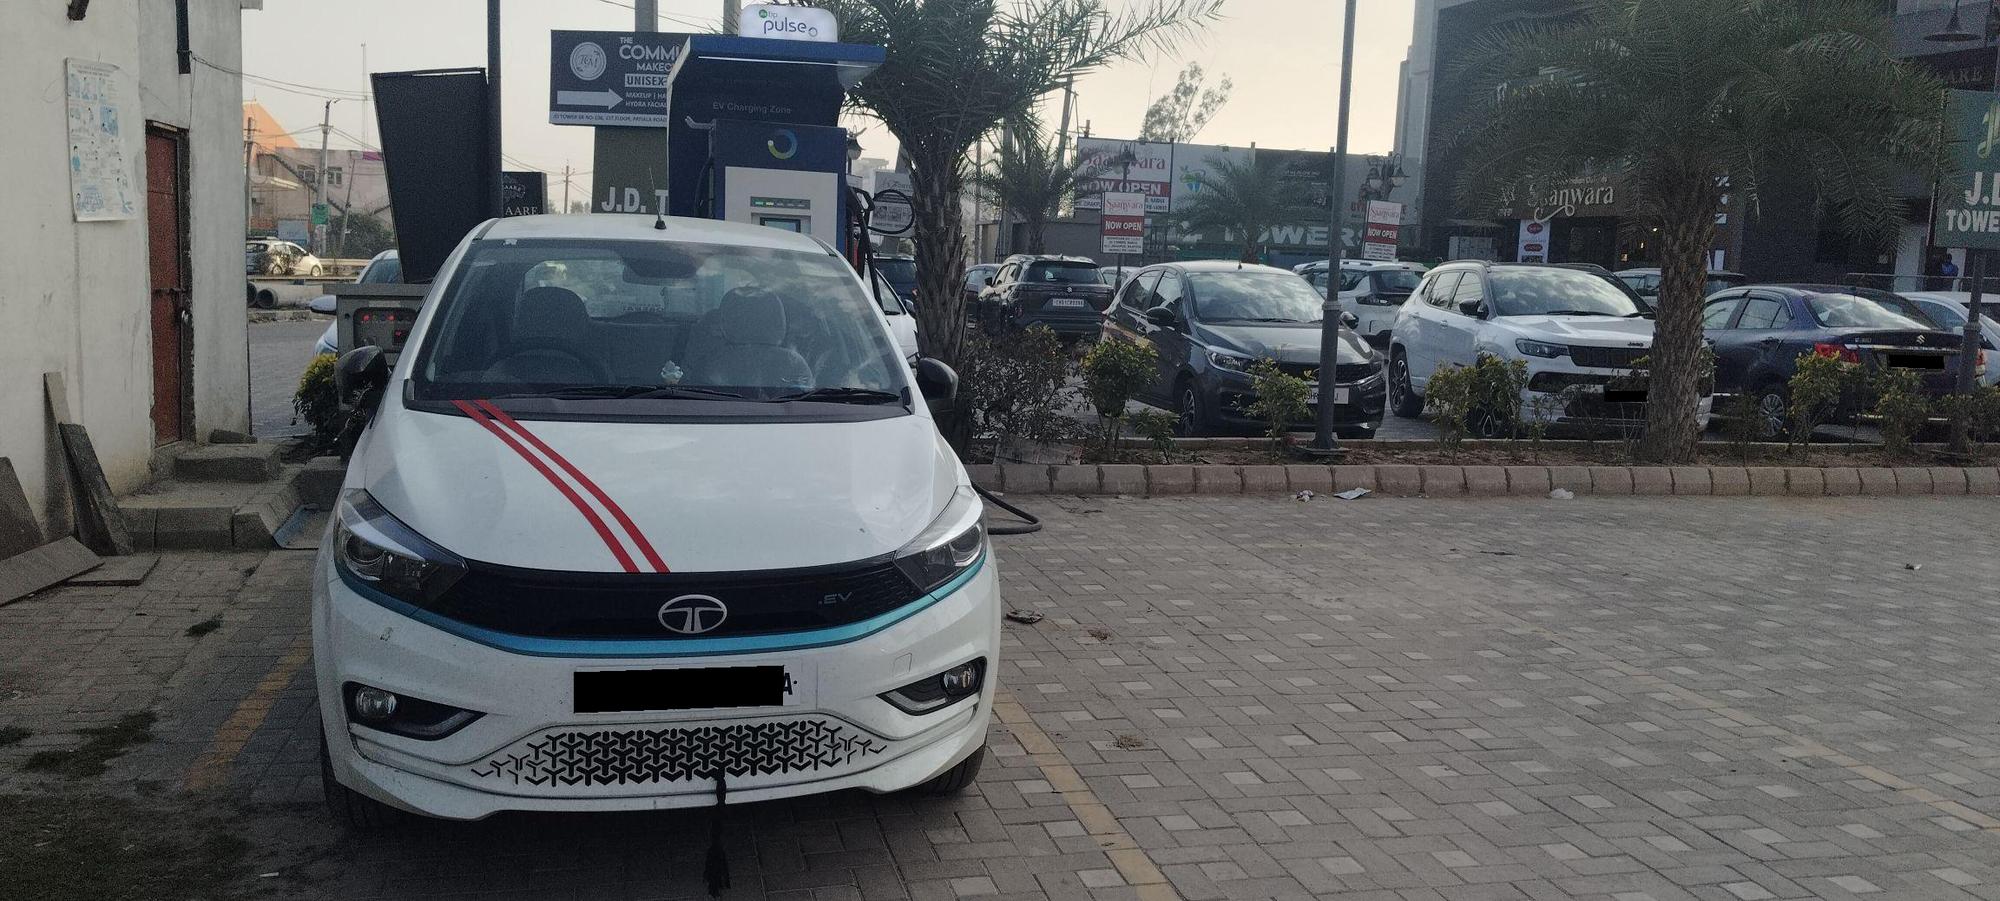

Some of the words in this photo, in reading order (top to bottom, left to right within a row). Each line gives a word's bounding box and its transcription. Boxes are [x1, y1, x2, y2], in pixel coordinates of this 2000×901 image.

[763, 17, 807, 34] pulse
[619, 44, 681, 60] COMM
[713, 101, 724, 110] EV
[727, 102, 767, 113] Charging
[769, 104, 791, 114] Zone
[1119, 181, 1162, 195] OPEN
[602, 186, 646, 213] J.D.
[1105, 220, 1122, 230] NOW
[1123, 221, 1142, 232] OPEN
[1367, 227, 1381, 238] NOW
[1381, 229, 1398, 240] OPEN
